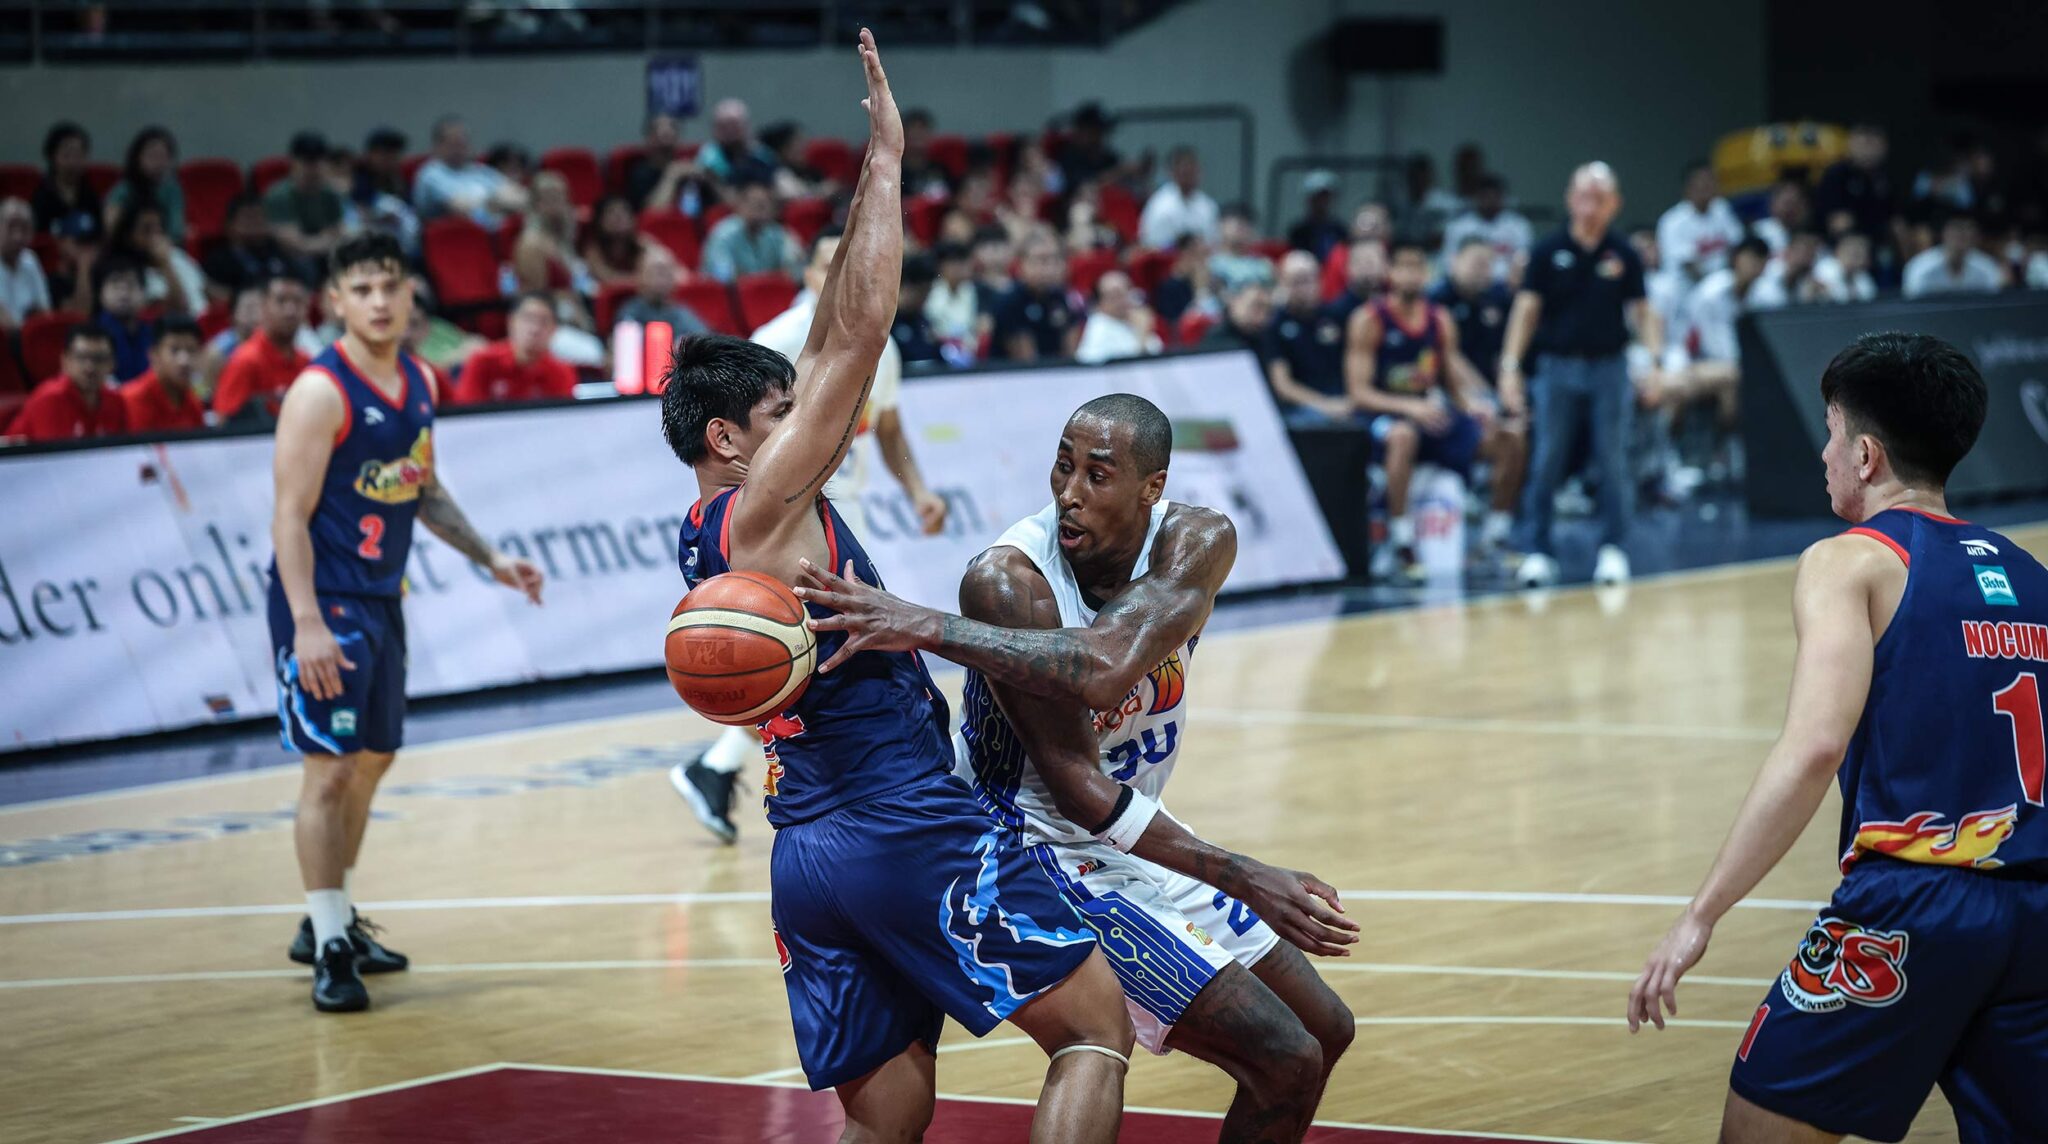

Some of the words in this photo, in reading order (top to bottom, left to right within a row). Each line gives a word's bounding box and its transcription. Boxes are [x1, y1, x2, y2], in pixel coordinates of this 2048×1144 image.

[358, 514, 385, 561] 2
[1981, 576, 2008, 589] Sista
[1961, 619, 2048, 662] NOCUM
[1992, 671, 2046, 808] 1
[1792, 993, 1844, 1010] PAINTERS
[1738, 1002, 1771, 1063] 1
